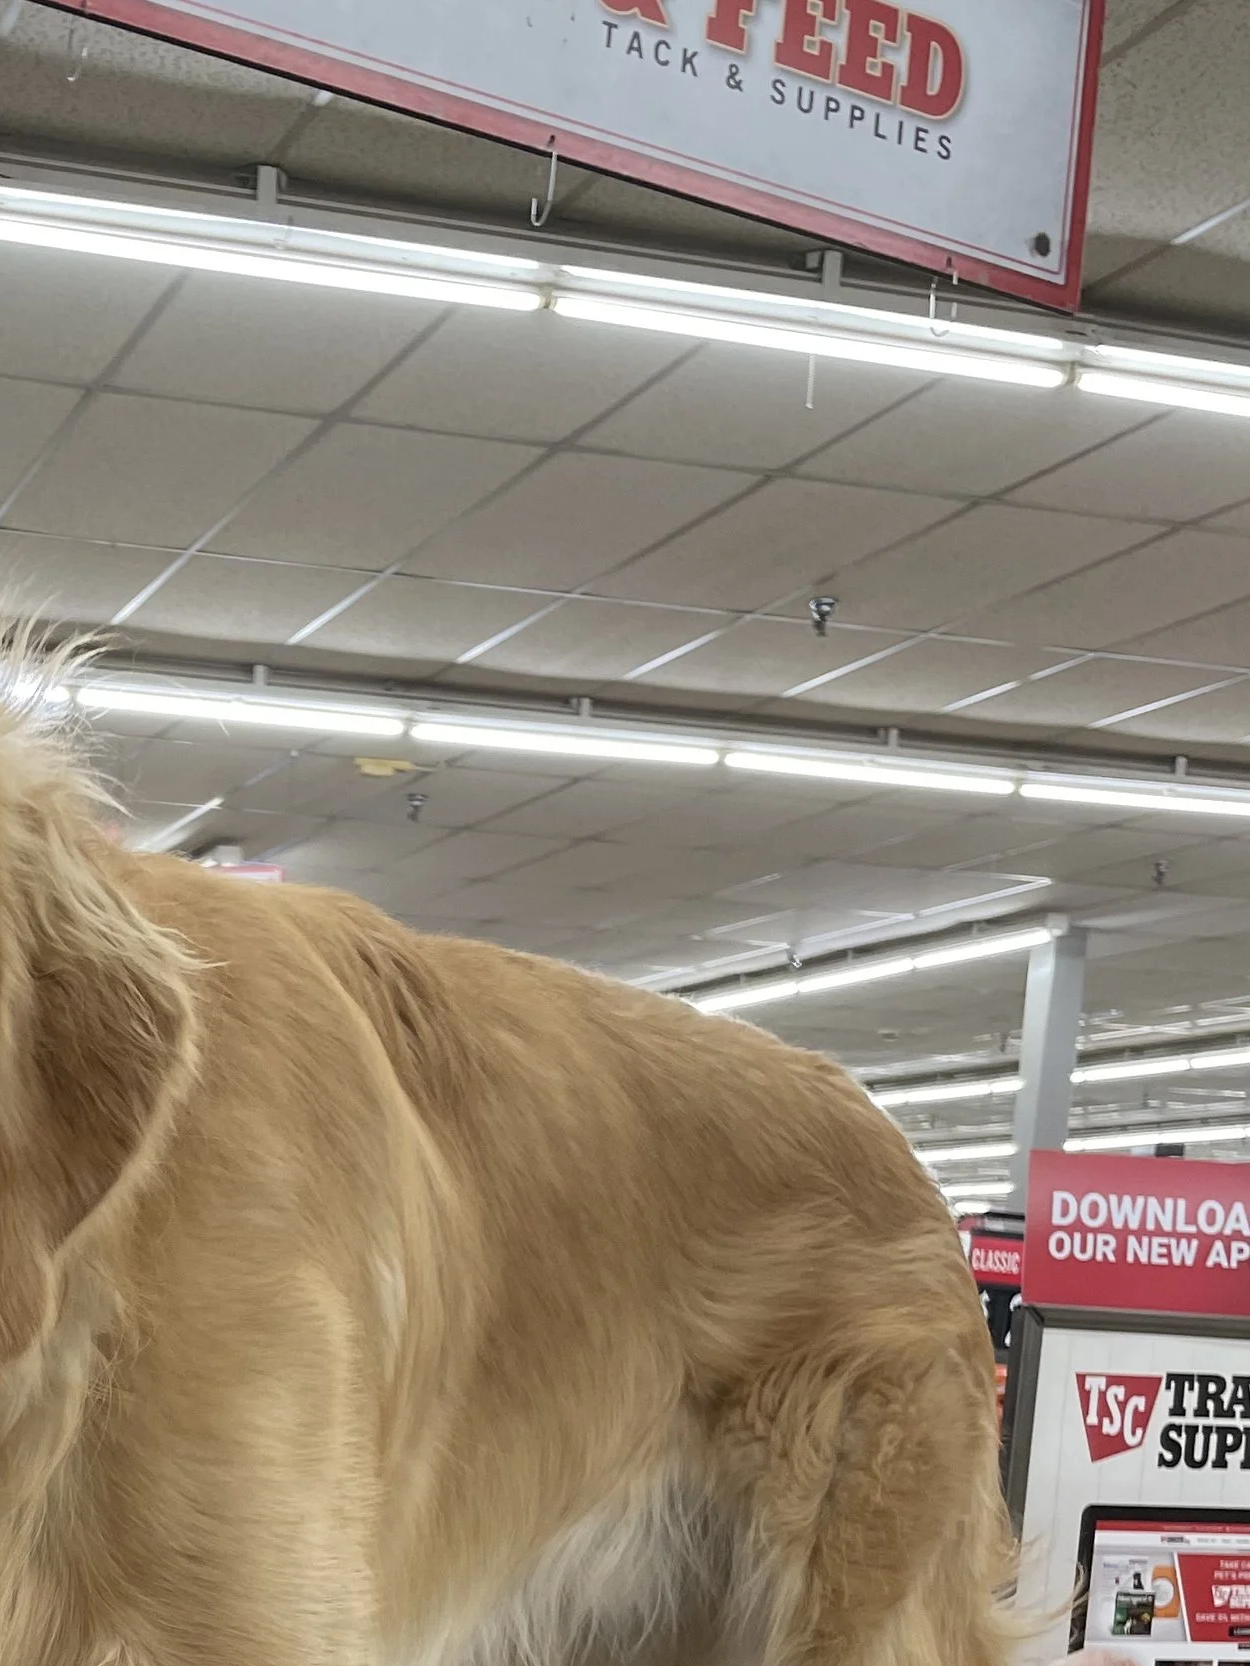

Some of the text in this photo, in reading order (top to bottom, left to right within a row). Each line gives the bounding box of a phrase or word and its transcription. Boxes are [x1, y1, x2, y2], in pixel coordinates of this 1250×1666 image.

[602, 19, 953, 161] TACK & SUPPLIES
[1051, 1190, 1250, 1238] DOWNLOA
[971, 1246, 1021, 1275] CLASSIC
[1048, 1229, 1250, 1271] OUR NEW AP
[1083, 1375, 1147, 1449] TSC
[1164, 1371, 1250, 1419] TRA
[1157, 1423, 1250, 1470] SUP
